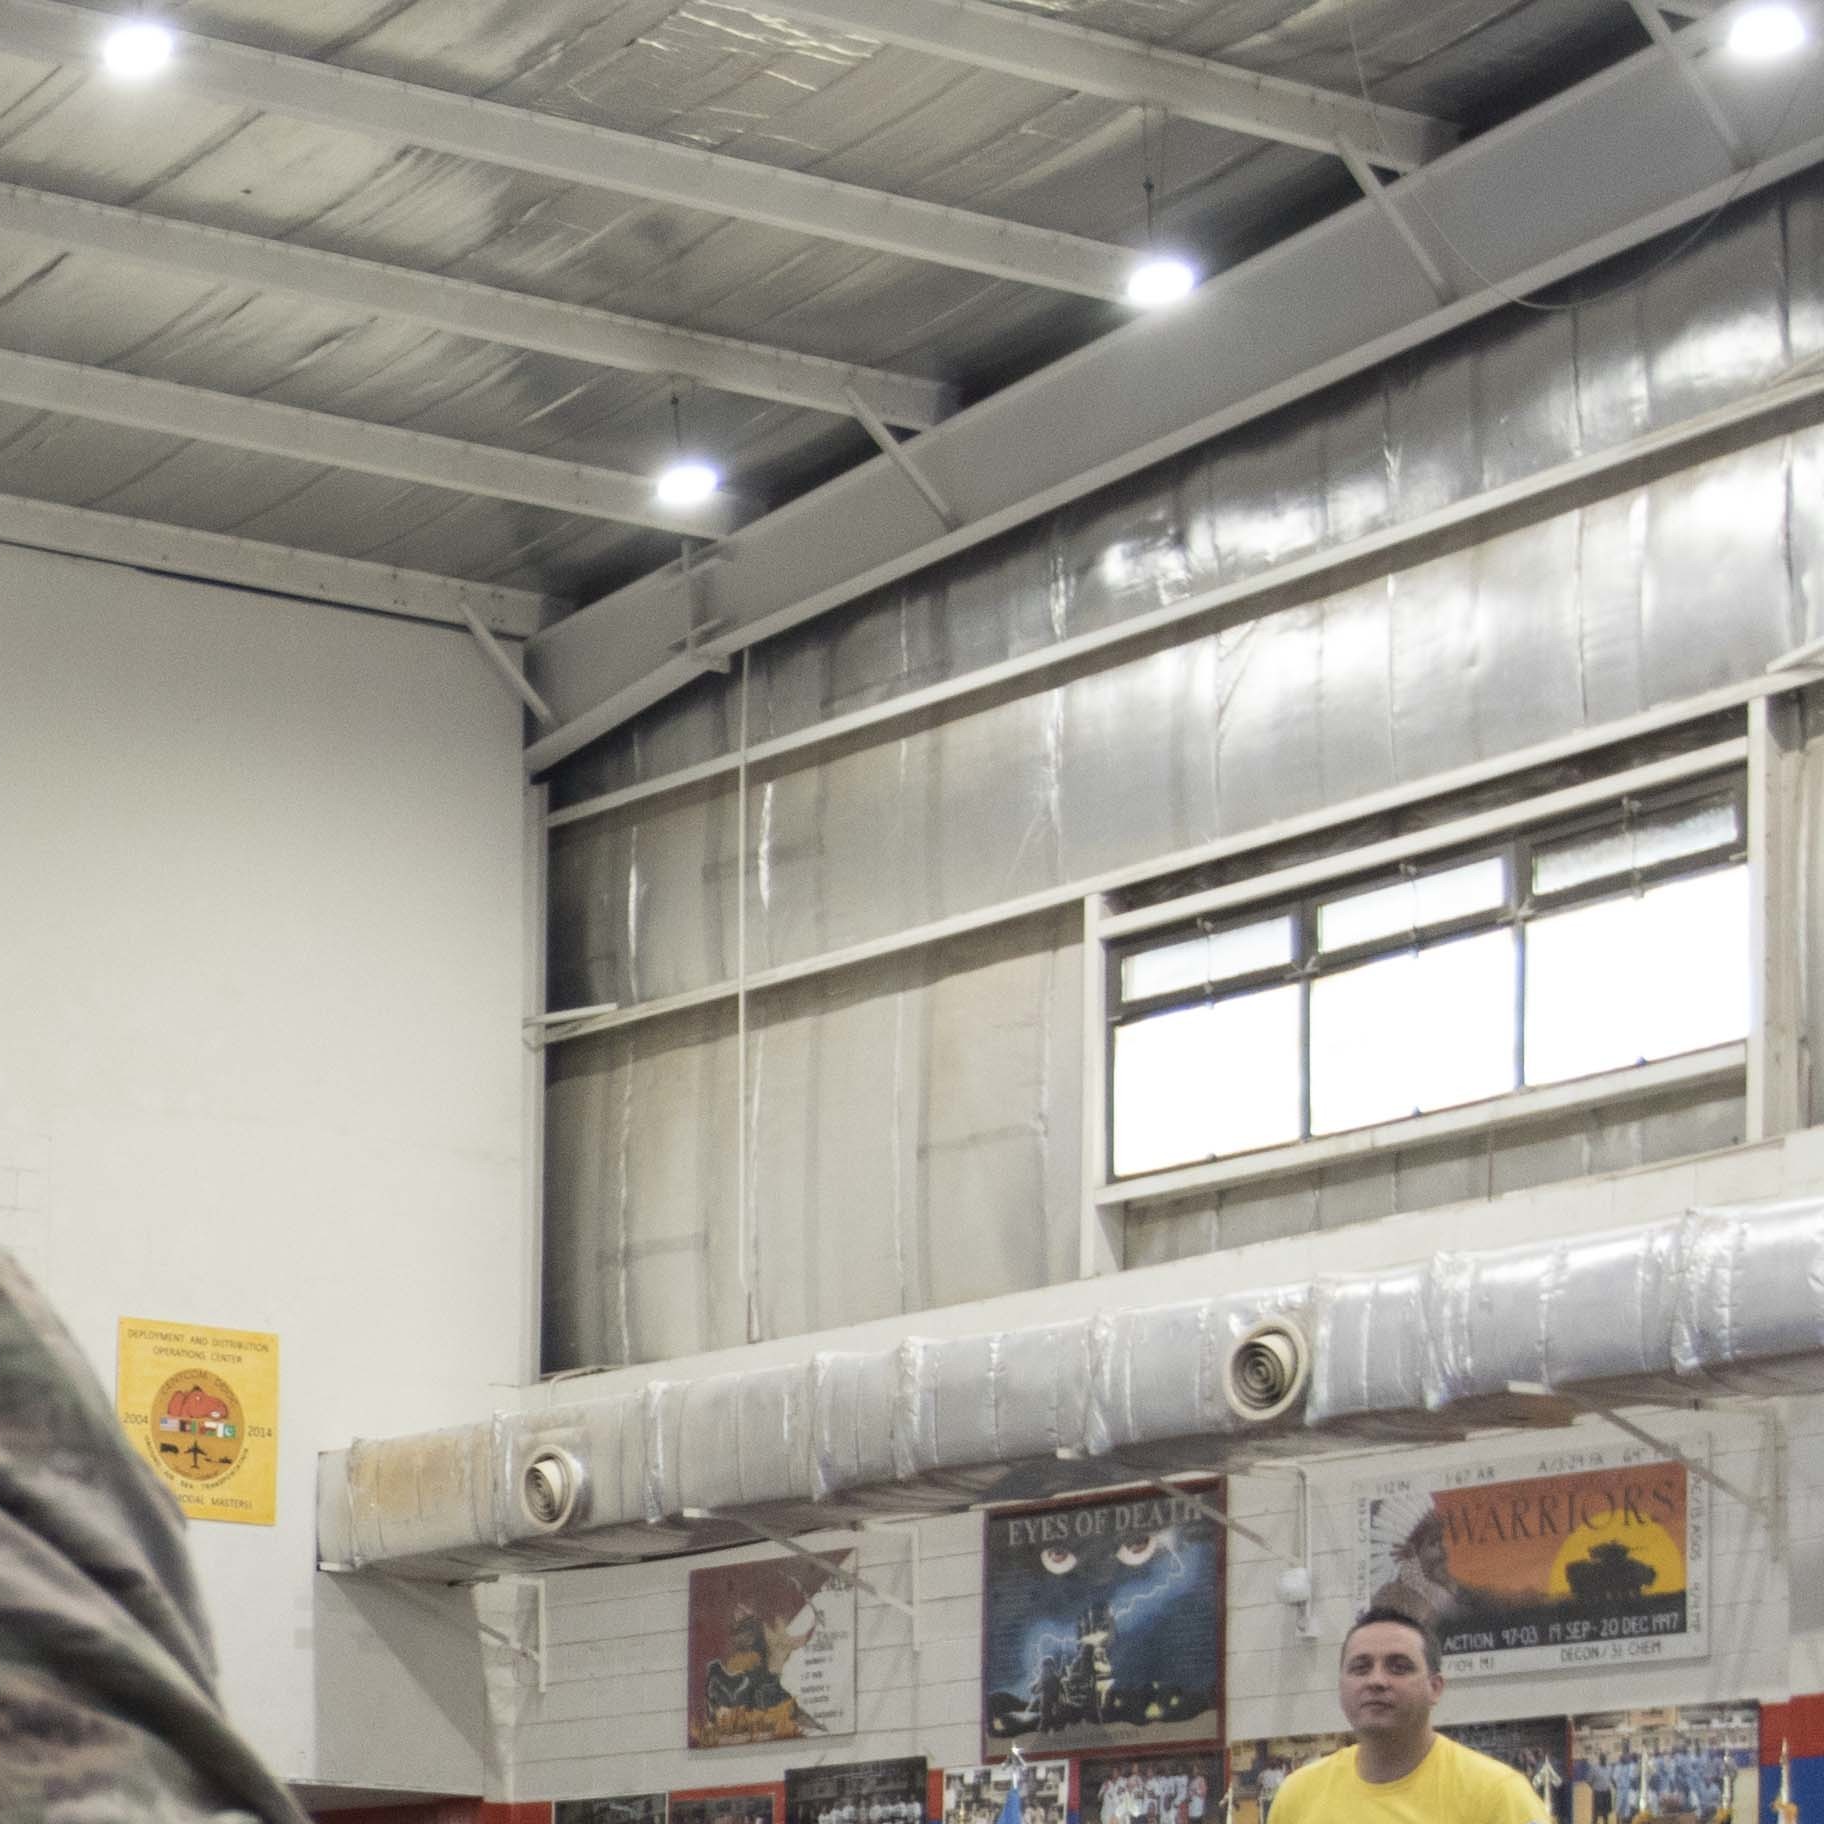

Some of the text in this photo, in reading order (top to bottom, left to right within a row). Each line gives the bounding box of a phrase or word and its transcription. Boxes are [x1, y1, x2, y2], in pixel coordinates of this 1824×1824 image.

[127, 1328, 270, 1352] DEPLOYMENT AND DISTRIBUTION
[152, 1346, 242, 1364] OPERATIONS CENTER
[122, 1412, 149, 1424] 2004
[247, 1425, 273, 1438] 2014
[1008, 1494, 1204, 1547] EYES OF DEATH
[1442, 1479, 1677, 1548] WARRIORS
[1443, 1631, 1495, 1652] ACTION
[1622, 1613, 1650, 1635] DEC
[1652, 1611, 1680, 1633] 1997
